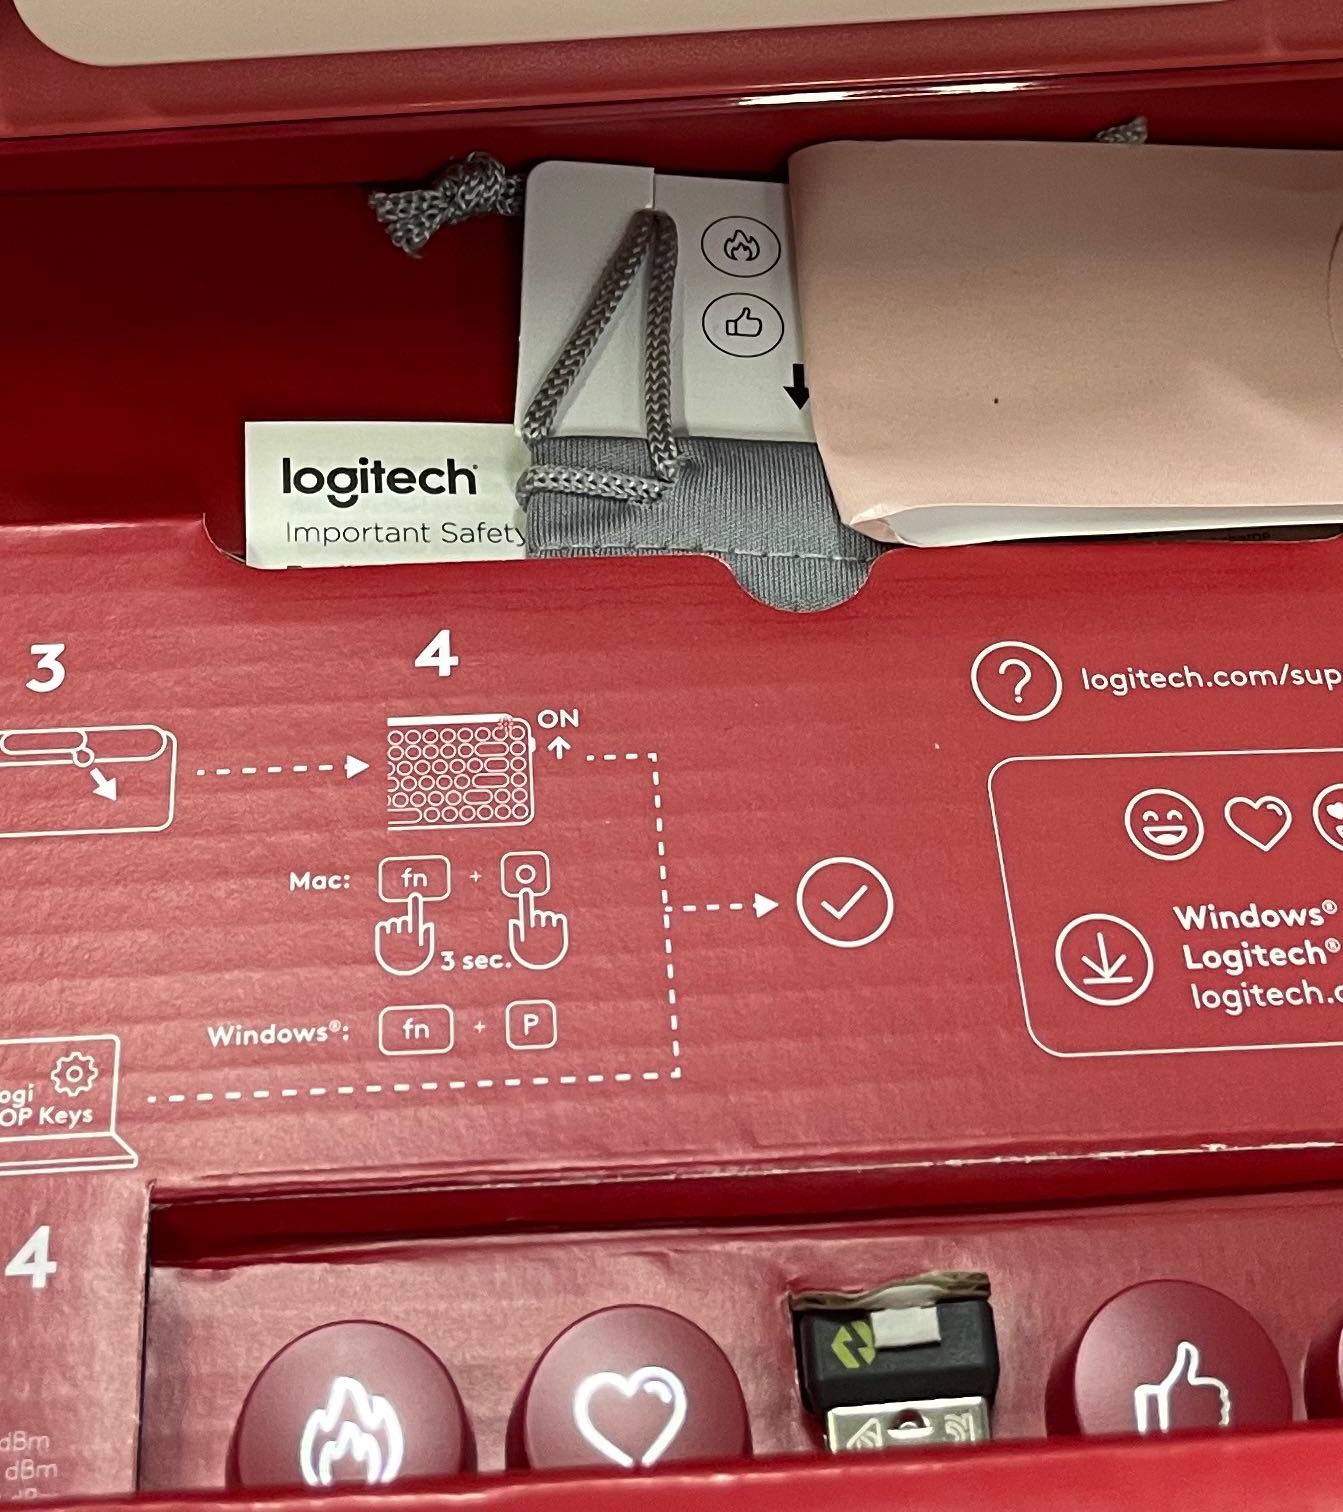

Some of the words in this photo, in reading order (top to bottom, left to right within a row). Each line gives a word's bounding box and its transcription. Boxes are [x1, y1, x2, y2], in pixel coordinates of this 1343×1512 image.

[282, 456, 479, 509] logitech
[287, 522, 431, 547] Important
[442, 522, 526, 546] Safety
[414, 629, 459, 677] 4
[25, 643, 67, 694] 3
[537, 708, 579, 730] ON
[289, 871, 351, 892] Mac:
[400, 867, 428, 888] fn
[440, 950, 456, 971] 3
[462, 953, 512, 970] sec.
[402, 1017, 430, 1040] fn
[523, 1013, 540, 1036] P
[39, 1105, 93, 1130] Keys
[4, 1225, 58, 1289] 4
[5, 1459, 58, 1481] dBm
